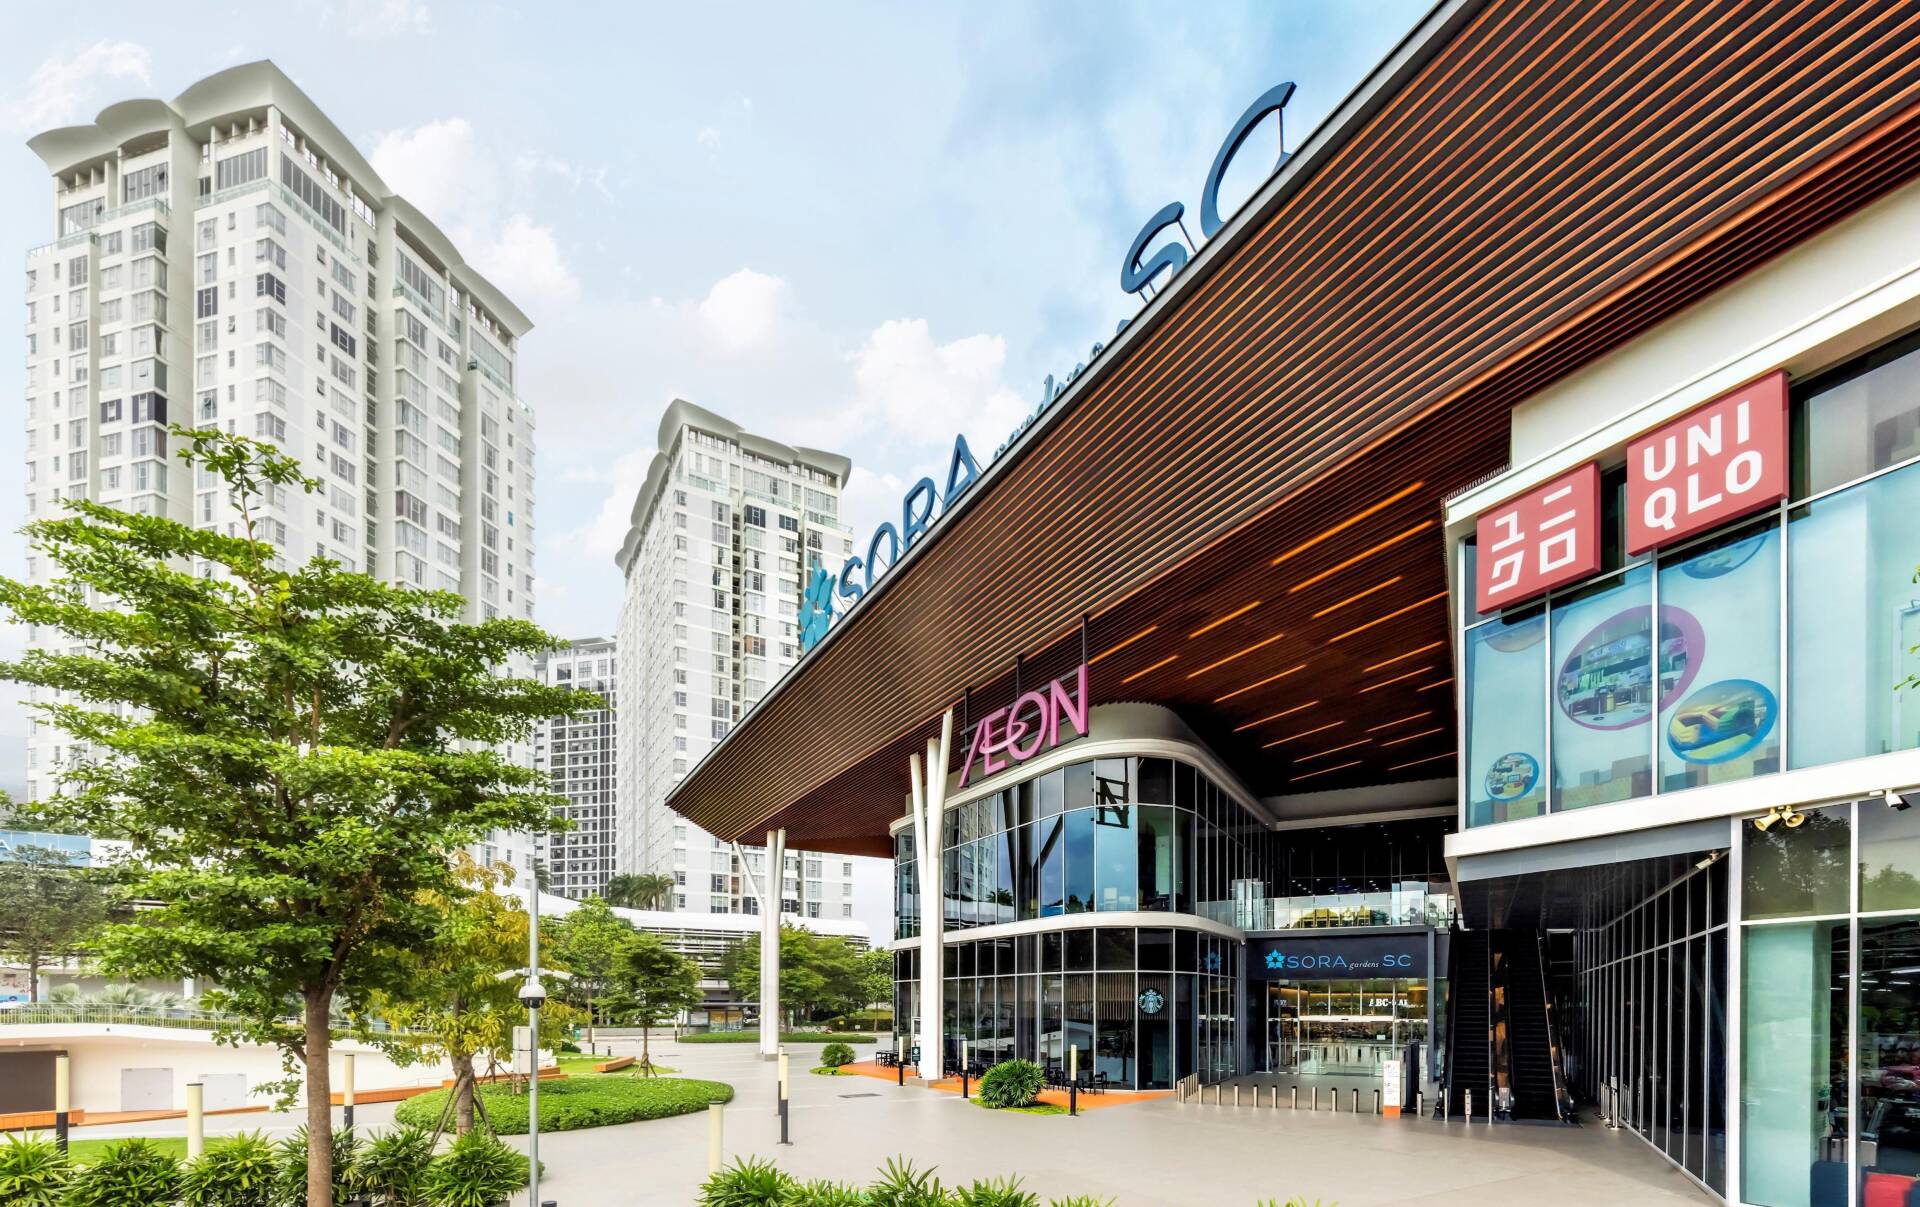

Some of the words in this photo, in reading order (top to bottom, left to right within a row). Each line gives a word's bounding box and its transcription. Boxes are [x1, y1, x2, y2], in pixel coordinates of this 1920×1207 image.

[1643, 400, 1749, 482] UNI
[839, 433, 977, 599] SORA
[1643, 450, 1762, 531] QLO
[1286, 955, 1347, 969] SORA
[1348, 960, 1380, 971] gardens
[1382, 954, 1412, 967] SC
